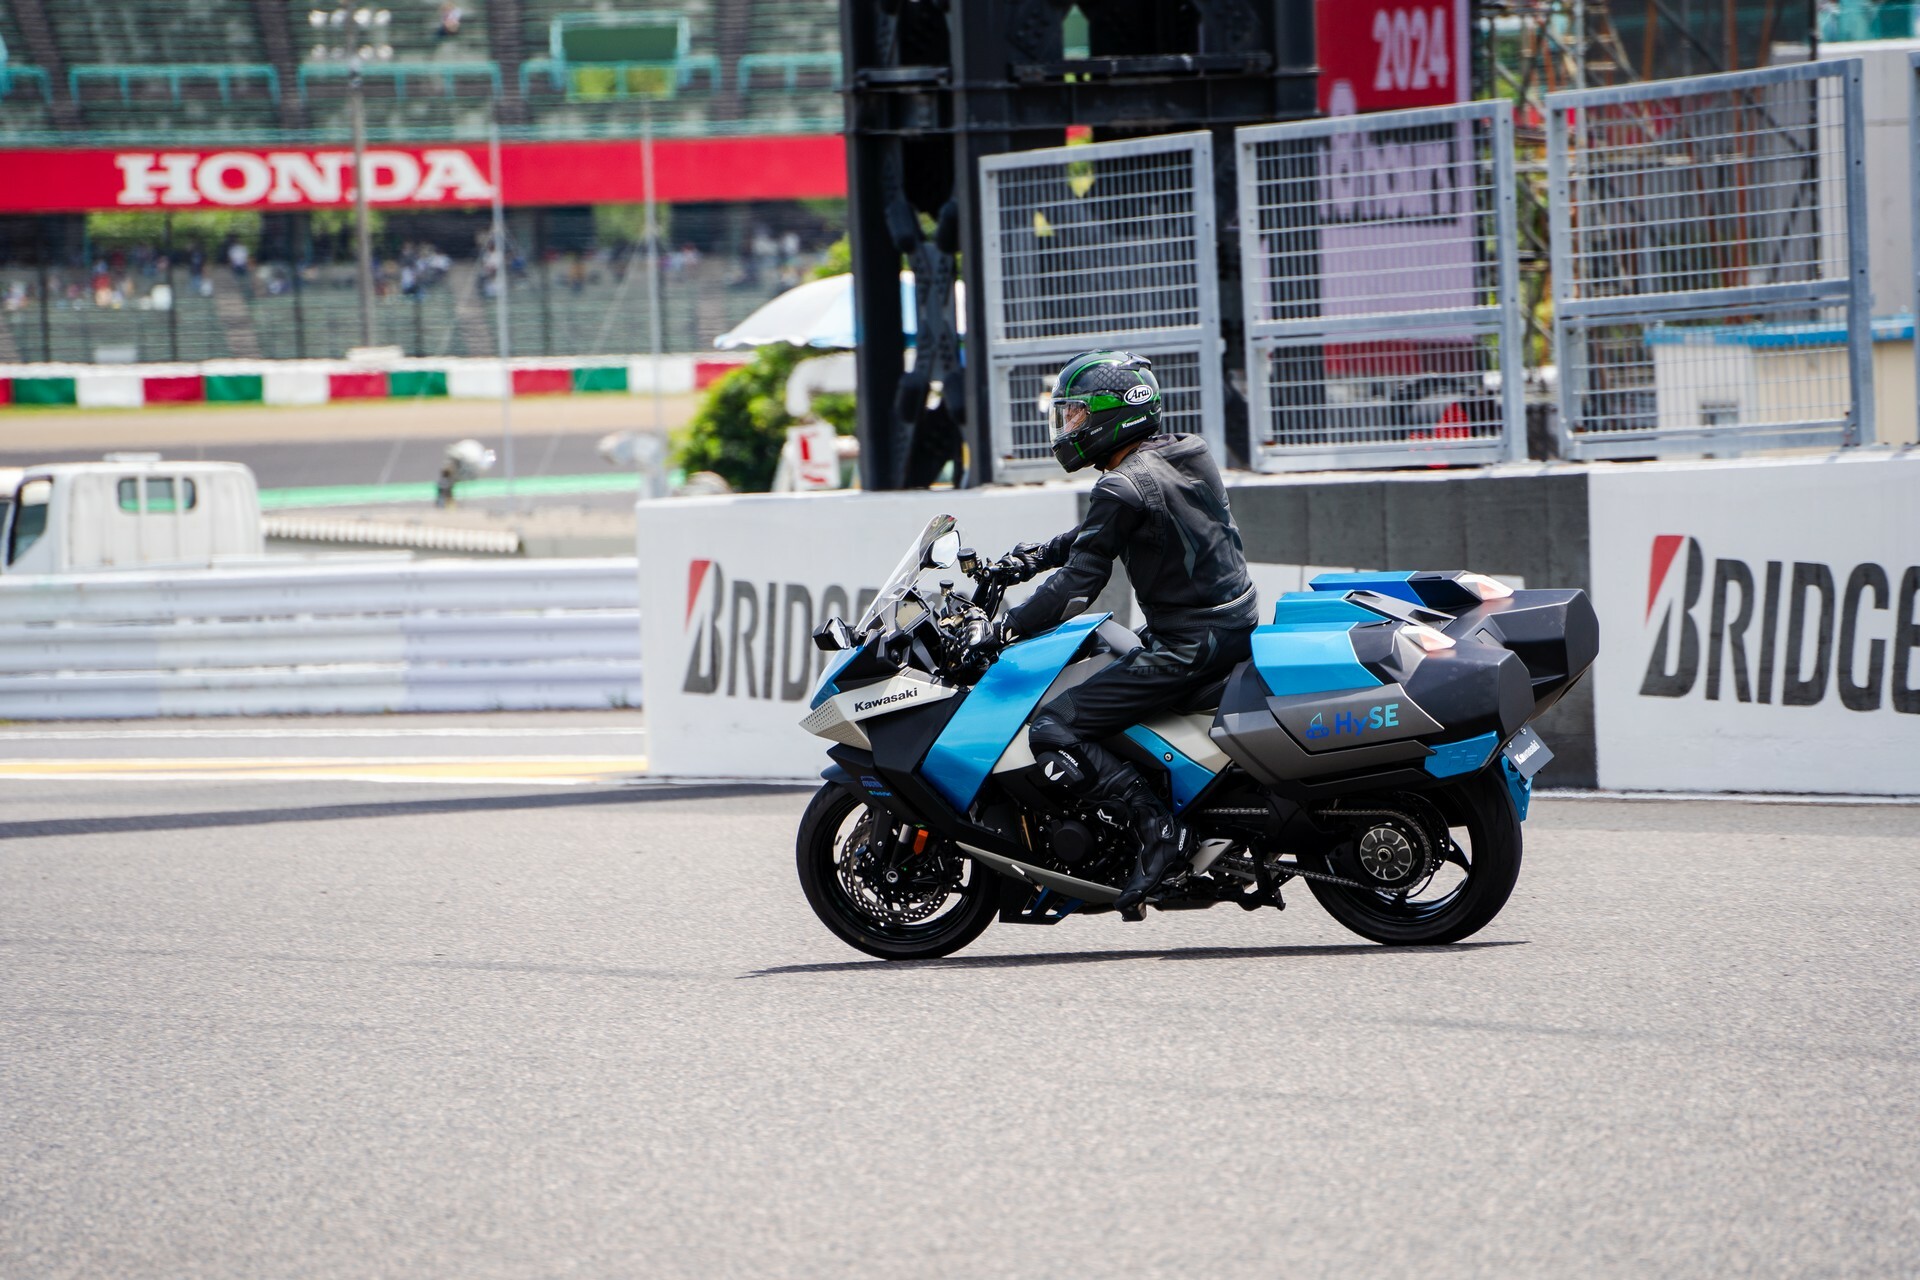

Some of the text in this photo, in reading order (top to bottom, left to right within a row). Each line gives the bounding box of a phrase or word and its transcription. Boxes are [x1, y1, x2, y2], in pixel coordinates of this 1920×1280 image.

[1372, 8, 1449, 90] 2024
[114, 149, 498, 206] HONDA
[854, 687, 918, 713] Kawasaki
[1335, 703, 1400, 737] HySE
[1514, 739, 1541, 765] Kawasaki
